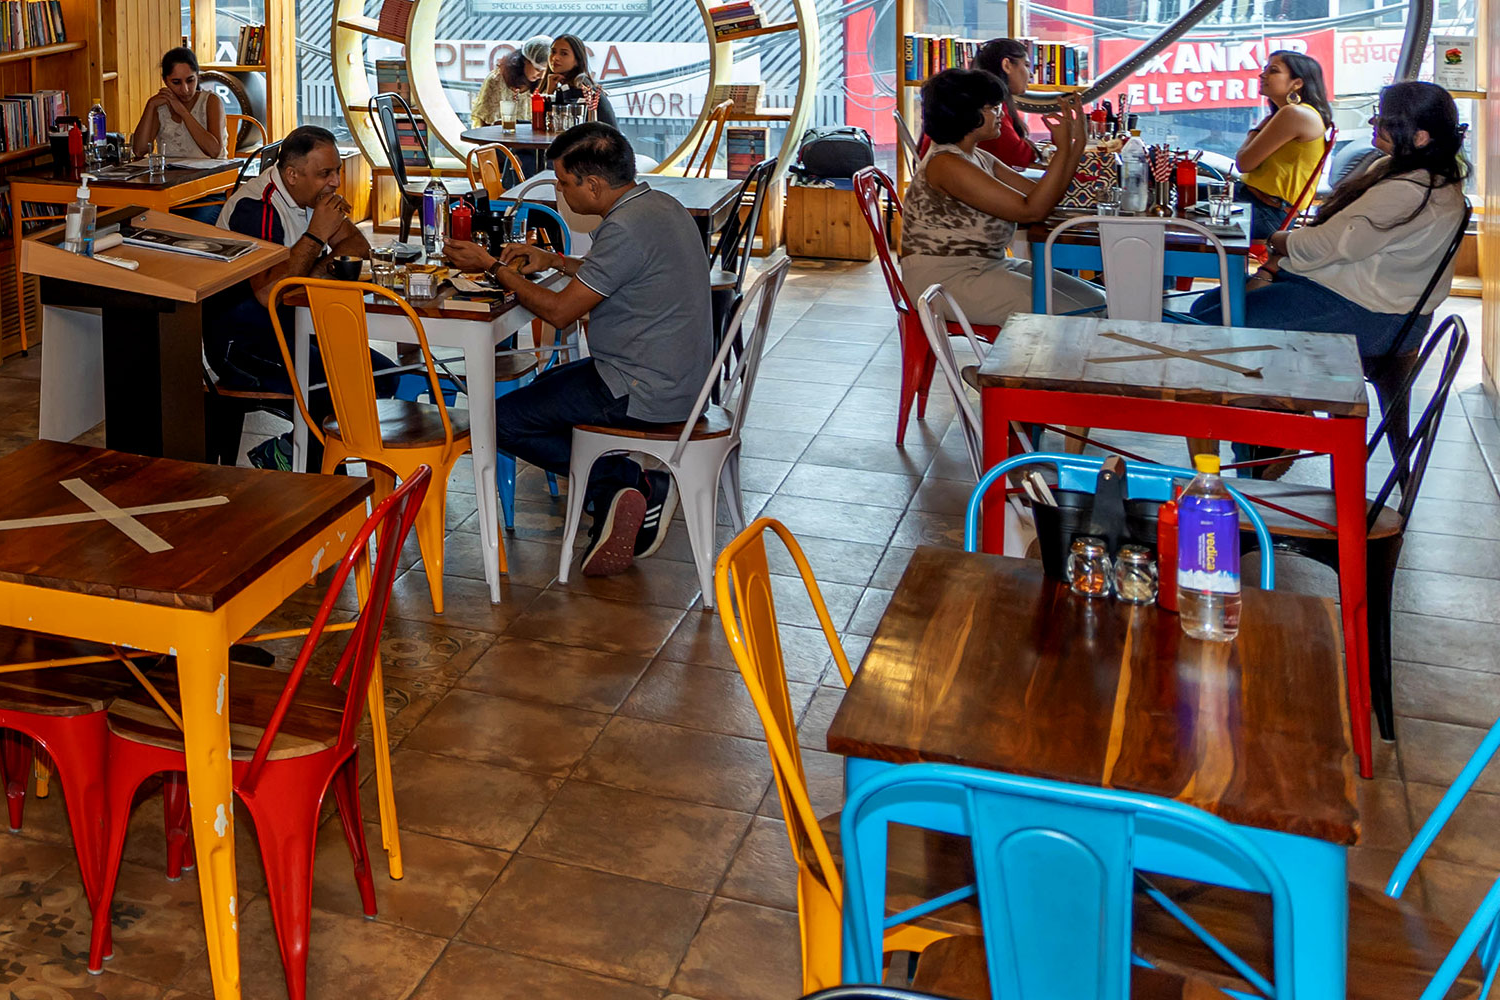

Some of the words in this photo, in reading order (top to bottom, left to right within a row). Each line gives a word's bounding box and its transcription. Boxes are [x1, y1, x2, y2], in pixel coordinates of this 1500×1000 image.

[491, 2, 533, 11] SPECTACLES
[536, 2, 581, 11] SUNGLASSES
[585, 2, 618, 11] CONTACT
[621, 2, 649, 11] LENSES
[625, 91, 703, 118] WORL
[1206, 532, 1217, 571] vedica
